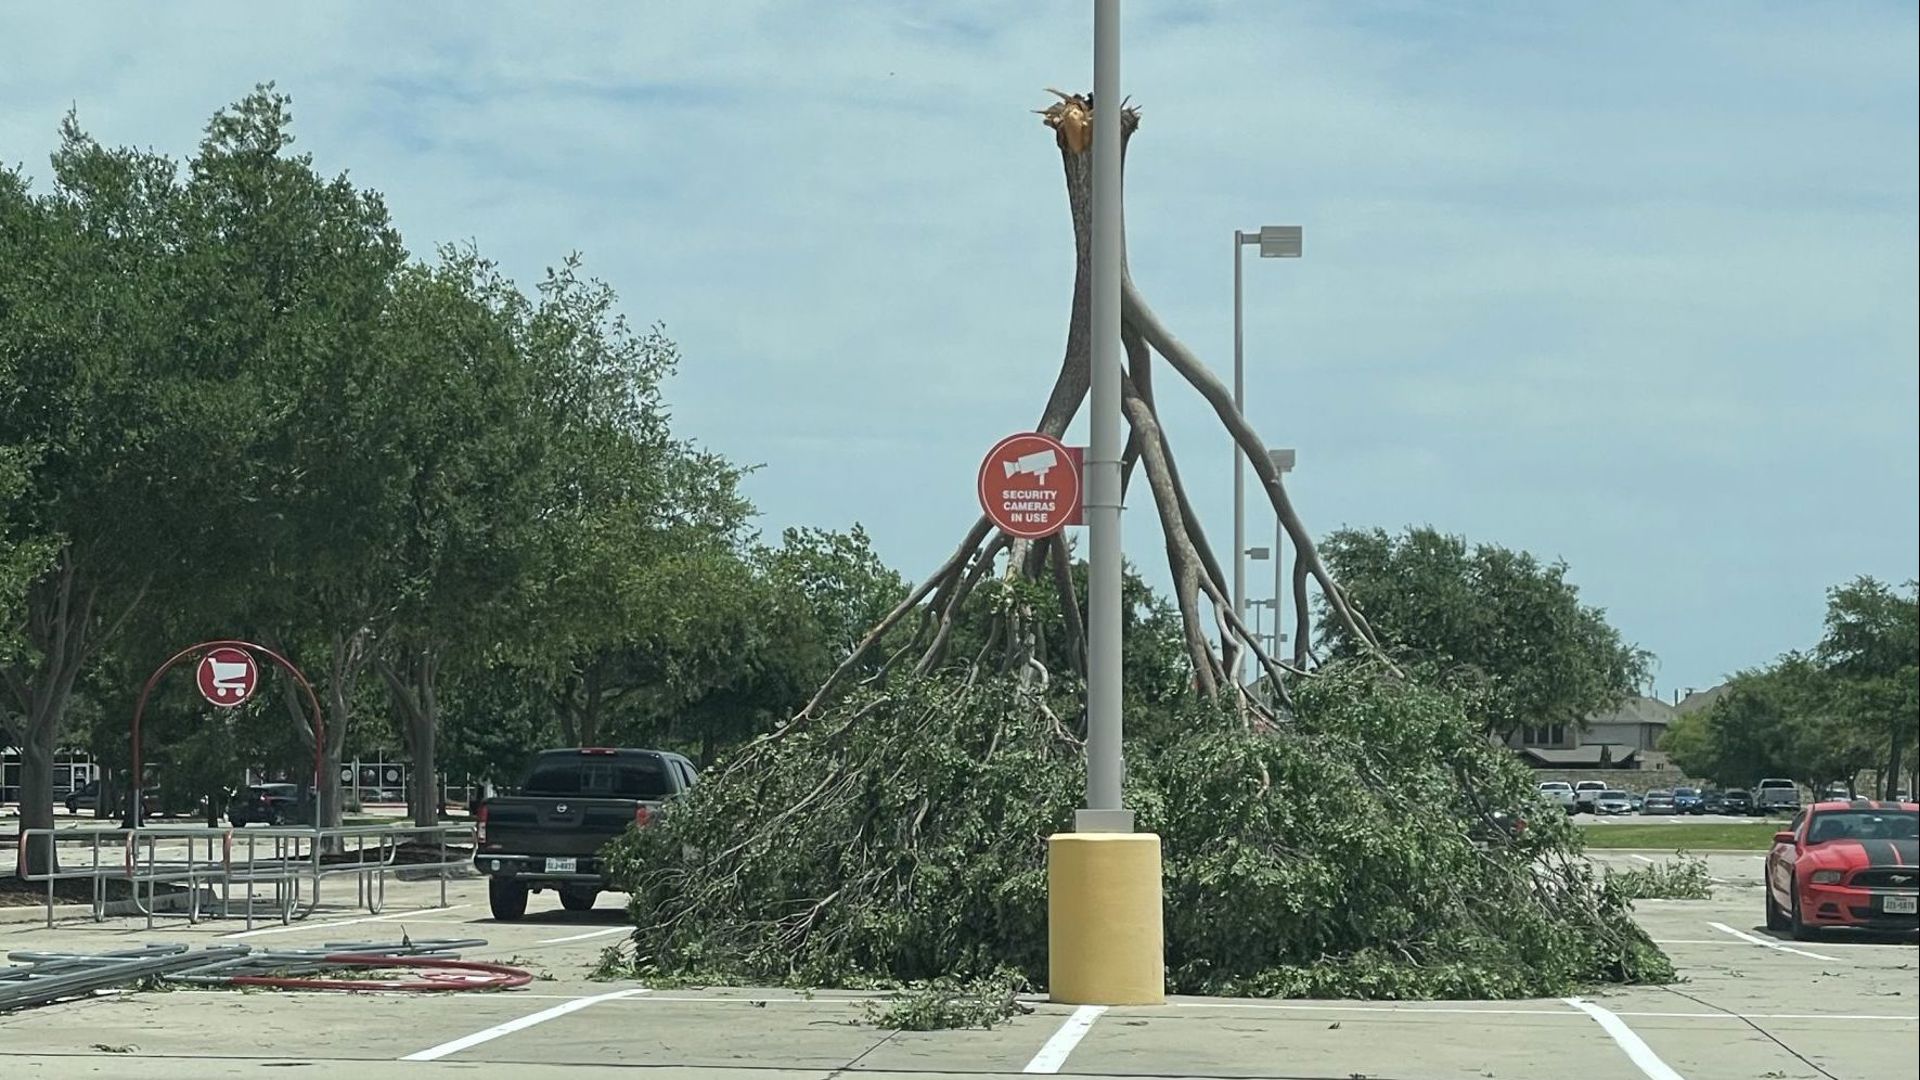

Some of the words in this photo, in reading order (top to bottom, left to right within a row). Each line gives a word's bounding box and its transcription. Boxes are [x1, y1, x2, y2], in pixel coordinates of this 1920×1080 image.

[1002, 490, 1057, 500] SECURITY
[1003, 502, 1056, 511] CAMERAS
[1011, 513, 1022, 522] IN
[1026, 513, 1048, 523] USE
